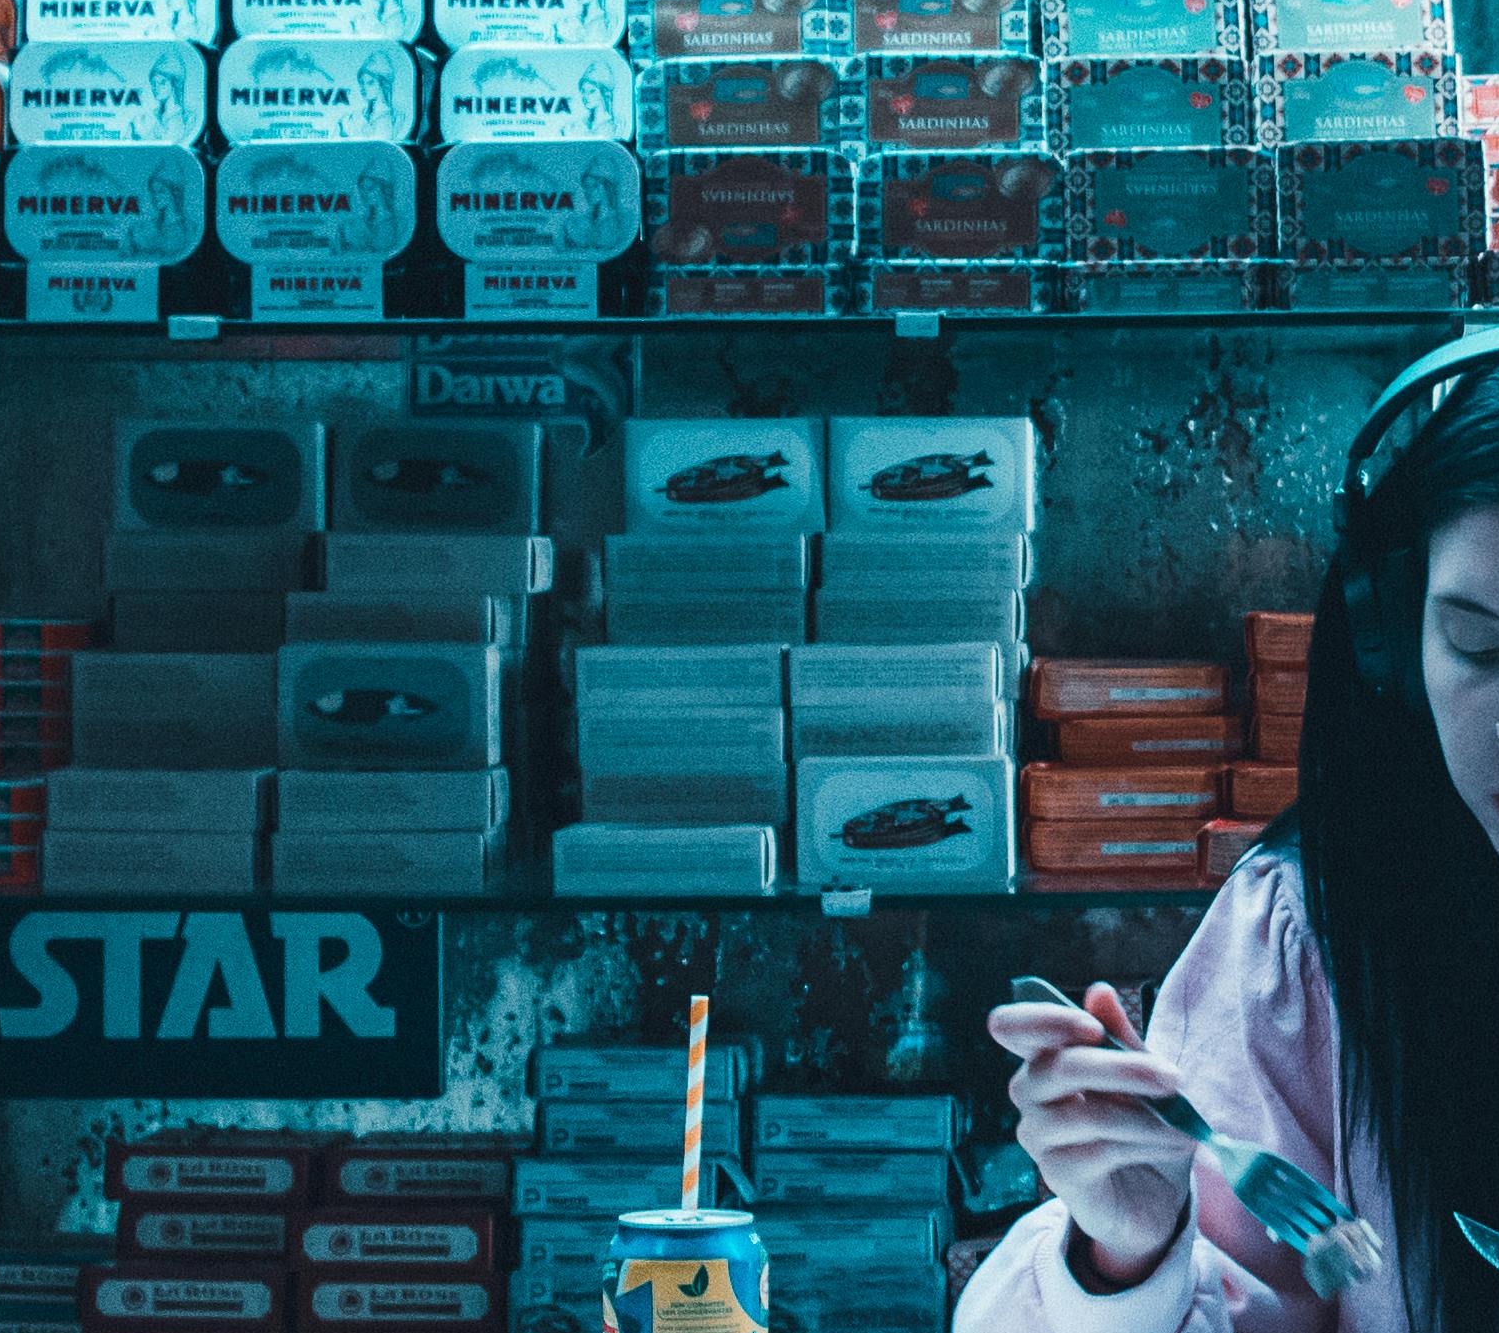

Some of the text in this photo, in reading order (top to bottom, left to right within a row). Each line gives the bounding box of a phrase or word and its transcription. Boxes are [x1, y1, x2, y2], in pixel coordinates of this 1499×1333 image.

[39, 0, 156, 18] MINERVA
[1305, 20, 1396, 36] SARDINHAS
[683, 31, 775, 47] SARDINHAS
[883, 31, 974, 47] SARDINHAS
[23, 86, 143, 108] MINERVA
[229, 85, 352, 108] MINERVA
[454, 95, 572, 115] MINERVA
[897, 116, 991, 131] SARDINHAS
[1315, 115, 1407, 130] SARDINHAS
[18, 193, 143, 217] MINERVA
[228, 192, 353, 216] MINERVA
[451, 191, 574, 214] MINERVA
[47, 275, 138, 292] MINERVA
[268, 276, 364, 293] MINERVA
[483, 275, 577, 293] MINERVA
